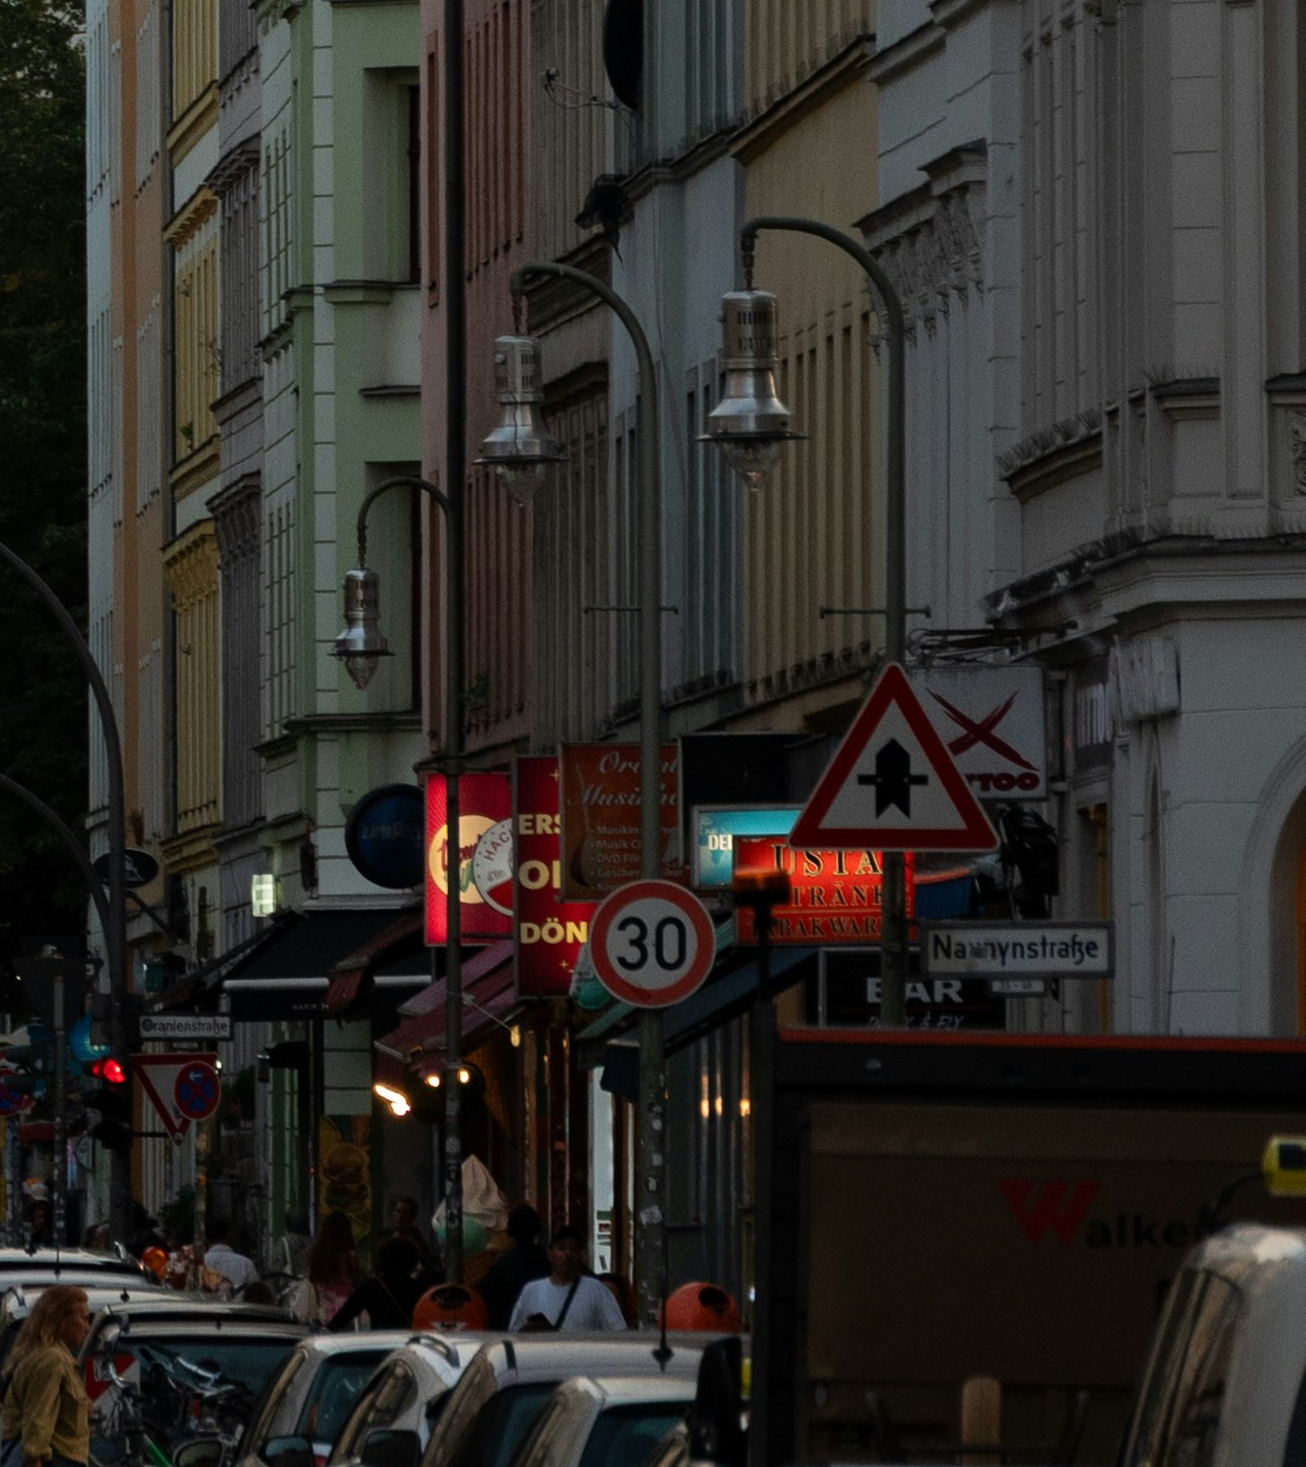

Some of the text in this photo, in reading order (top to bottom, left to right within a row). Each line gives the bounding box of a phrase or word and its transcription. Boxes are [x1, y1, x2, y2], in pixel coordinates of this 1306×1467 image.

[617, 917, 686, 971] 30
[934, 935, 1098, 965] Nanynstraße
[141, 1017, 228, 1035] Oranienstraße
